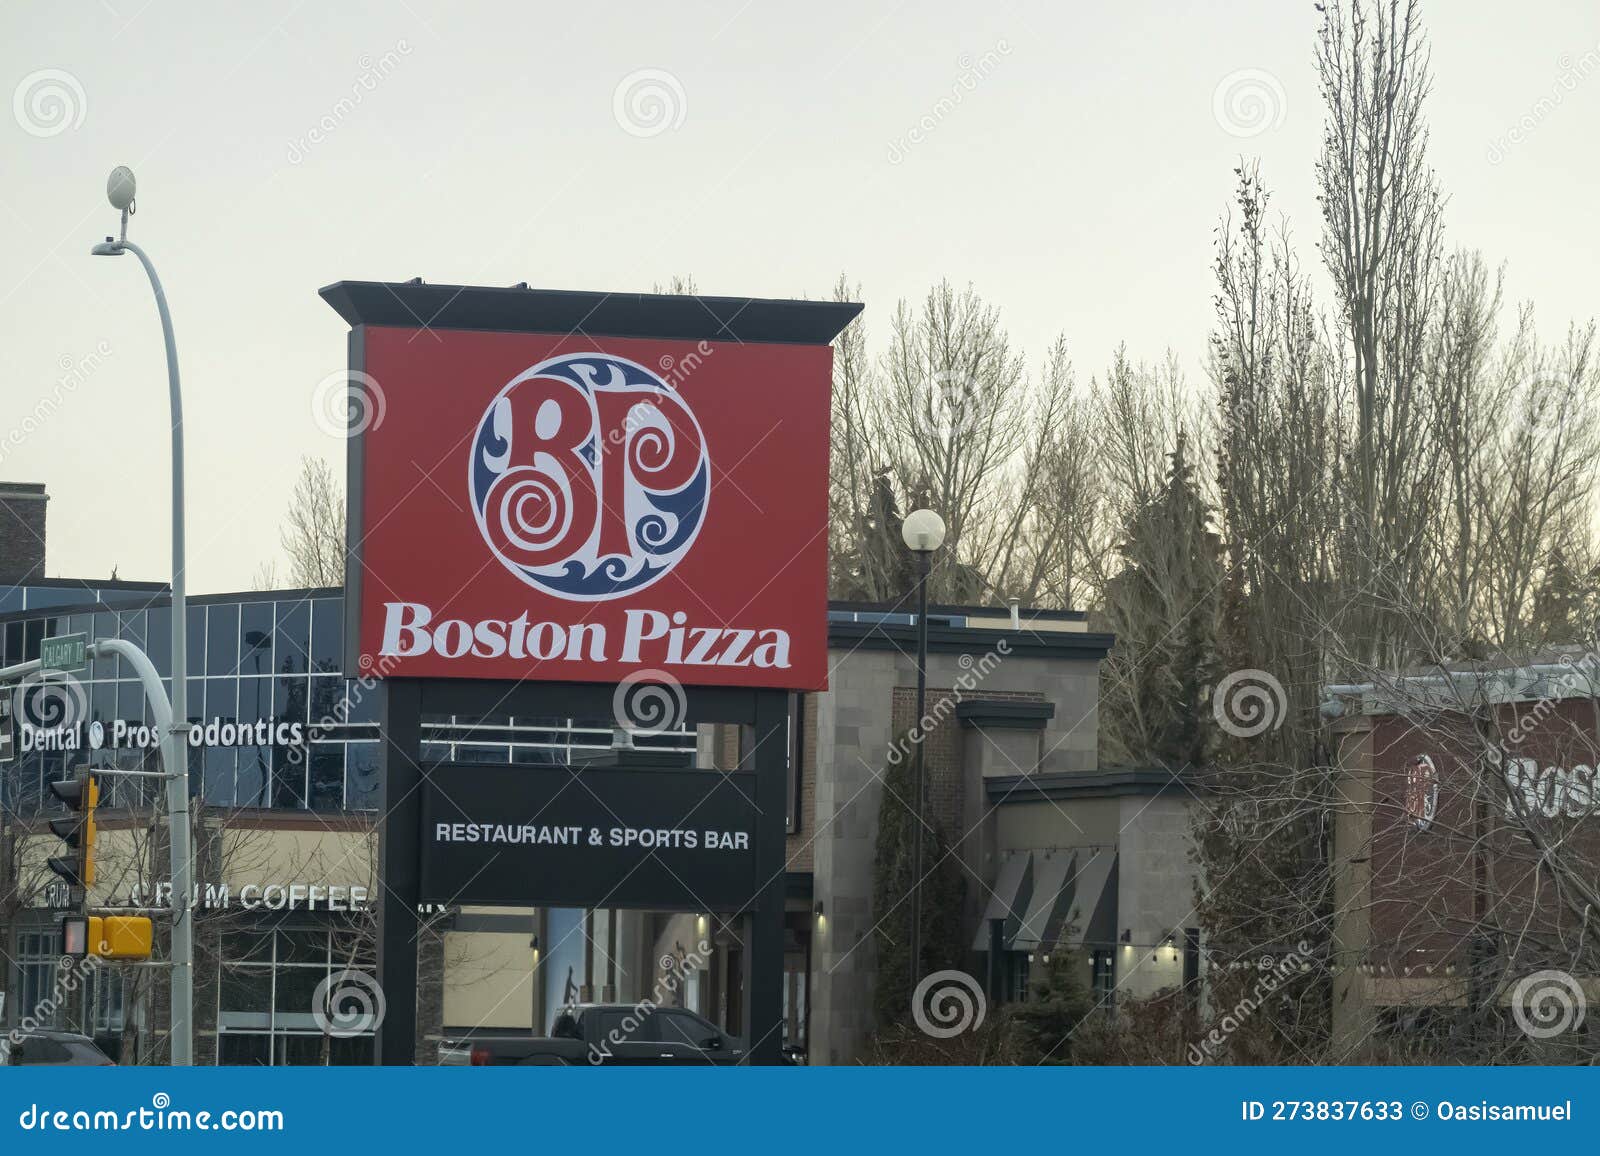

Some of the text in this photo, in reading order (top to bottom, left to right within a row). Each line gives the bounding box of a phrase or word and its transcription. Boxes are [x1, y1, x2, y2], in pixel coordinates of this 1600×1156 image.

[378, 602, 792, 670] Boston Pizza
[20, 716, 302, 752] Dental Prosodontics
[436, 823, 749, 850] RESTAURANT & SPORTS BAR
[240, 884, 369, 912] COFFEE
